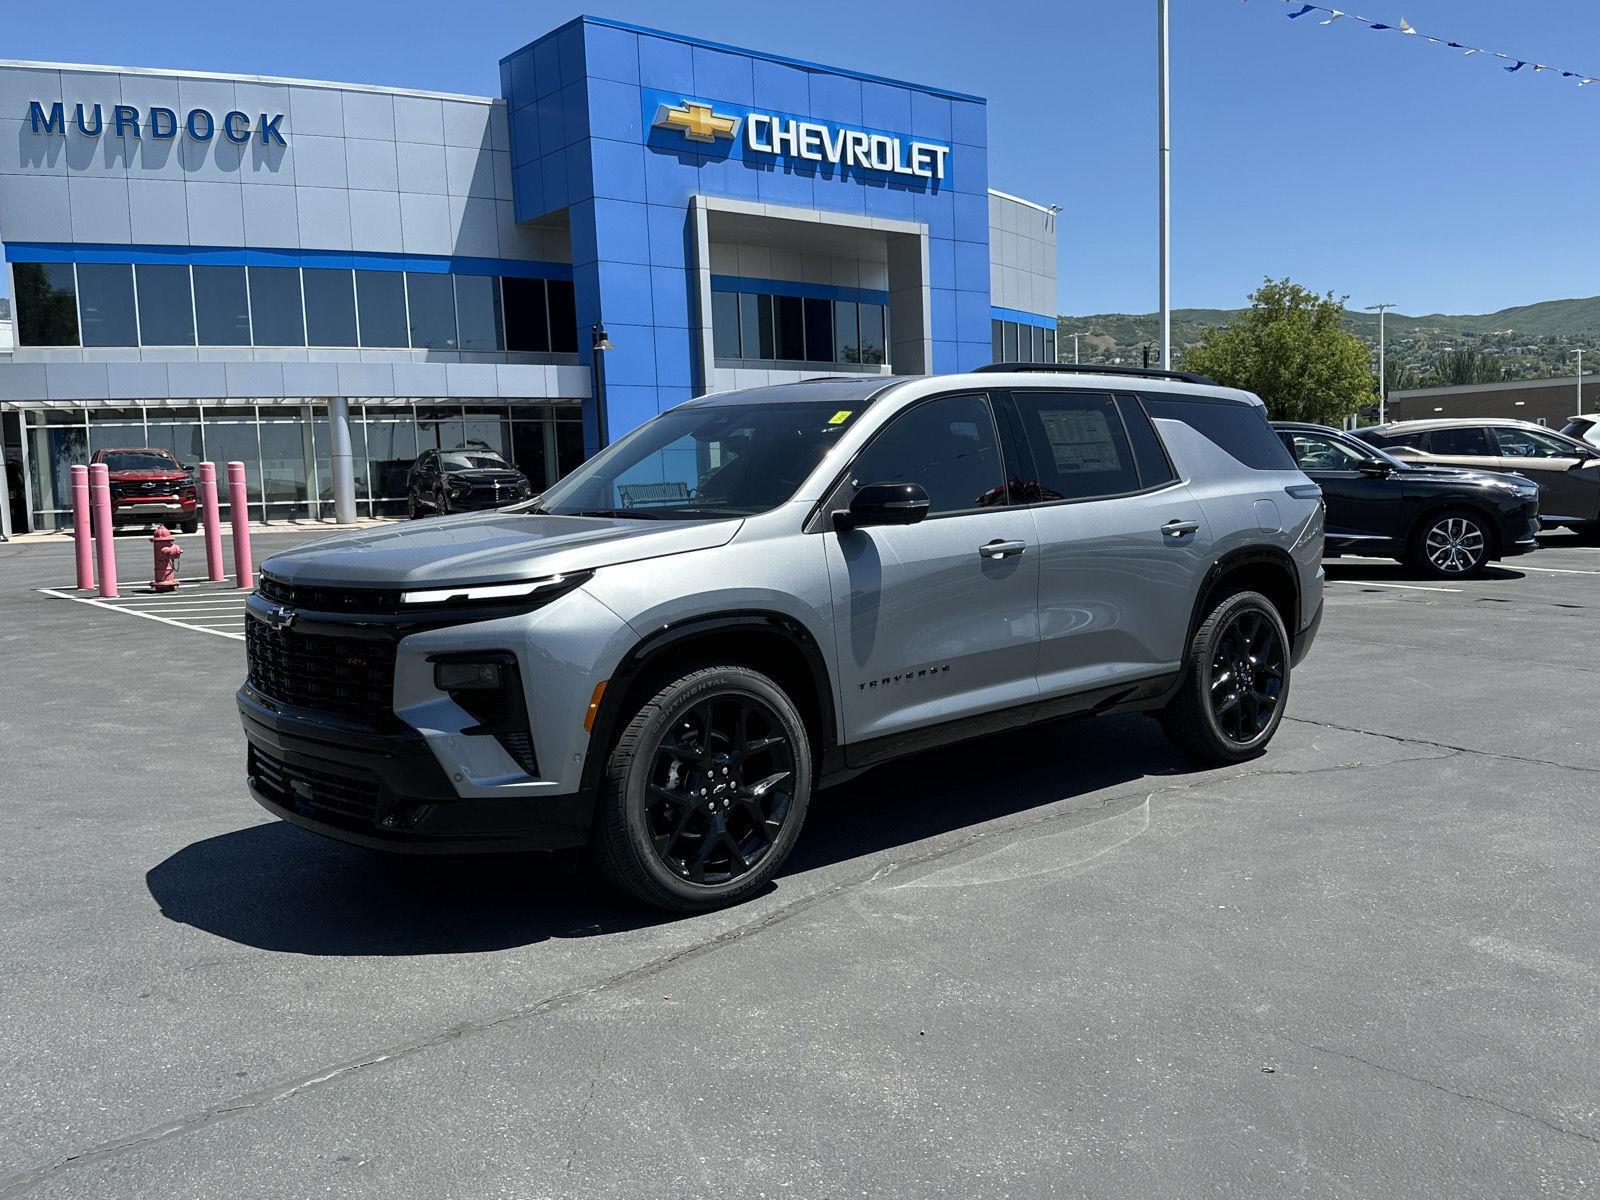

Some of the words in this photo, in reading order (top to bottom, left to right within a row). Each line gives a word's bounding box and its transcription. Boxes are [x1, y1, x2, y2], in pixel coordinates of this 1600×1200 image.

[29, 101, 288, 146] MURDOCK
[747, 112, 950, 179] CHEVROLET
[858, 665, 951, 690] TRAVERSE
